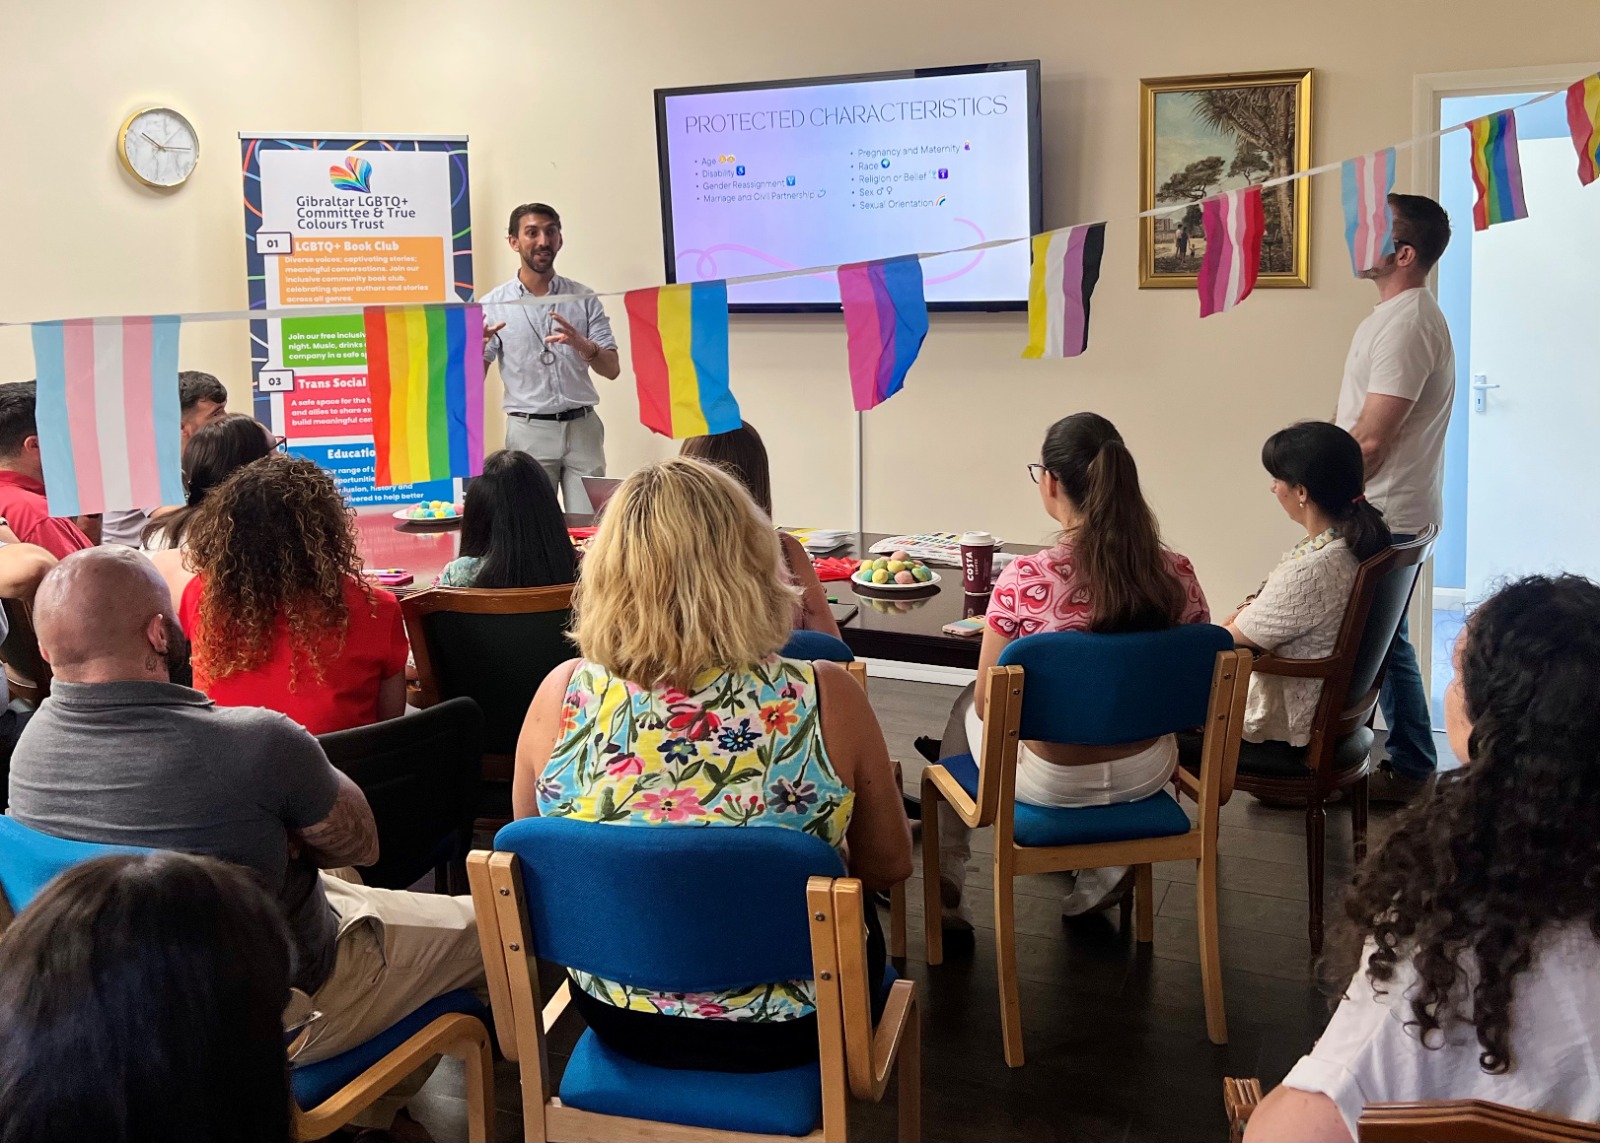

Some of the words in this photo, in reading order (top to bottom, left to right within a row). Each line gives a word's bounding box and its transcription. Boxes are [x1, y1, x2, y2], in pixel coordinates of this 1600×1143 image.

[685, 109, 805, 134] PROTECTED
[809, 95, 1008, 127] CHARACTERISTICS
[858, 148, 901, 158] Pregnancy
[903, 146, 919, 155] and
[921, 144, 960, 154] Maternity
[701, 157, 717, 167] Age
[858, 162, 879, 171] Race
[702, 169, 735, 178] Disability
[859, 174, 891, 184] Religion
[893, 174, 902, 182] or
[903, 172, 927, 181] Belief
[703, 181, 731, 190] Gender
[732, 180, 785, 190] Reassignment
[703, 194, 736, 203] Marriage
[737, 194, 752, 202] and
[771, 191, 815, 200] Partnership
[859, 188, 874, 197] Sex
[296, 196, 354, 207] Gibraltar
[358, 196, 408, 208] LGBTQ+
[859, 200, 886, 210] Sexual
[888, 199, 934, 209] Orientation
[296, 207, 370, 218] Committee
[373, 207, 384, 218] &
[387, 207, 416, 218] True
[297, 218, 347, 230] Colours
[350, 218, 385, 230] Trust
[266, 239, 279, 248] 01
[295, 241, 341, 253] LGBTQ+
[343, 241, 372, 252] Book
[374, 240, 400, 252] Club
[284, 256, 315, 264] Diverse
[343, 255, 389, 264] captivating
[284, 266, 330, 274] meaningful
[331, 265, 388, 273] conversations.
[321, 275, 367, 284] community
[286, 285, 331, 294] celebrating
[386, 284, 402, 292] and
[288, 332, 305, 340] Join
[336, 331, 366, 339] inclusiv
[288, 342, 312, 351] night.
[312, 342, 338, 350] Music,
[338, 341, 363, 349] drinks
[289, 353, 327, 361] company
[327, 351, 335, 359] in
[268, 377, 281, 386] 03
[298, 378, 331, 389] Trans
[332, 376, 367, 388] Social
[291, 399, 298, 407] A
[298, 398, 315, 406] safe
[316, 398, 340, 407] space
[341, 397, 352, 405] for
[308, 408, 330, 416] allies
[291, 418, 313, 426] build
[313, 416, 358, 426] meaningful
[327, 447, 376, 459] Educatio
[338, 467, 361, 476] range
[361, 465, 370, 473] of
[398, 483, 413, 491] and
[383, 494, 400, 502] help
[400, 492, 424, 500] better
[965, 551, 975, 582] COSTA
